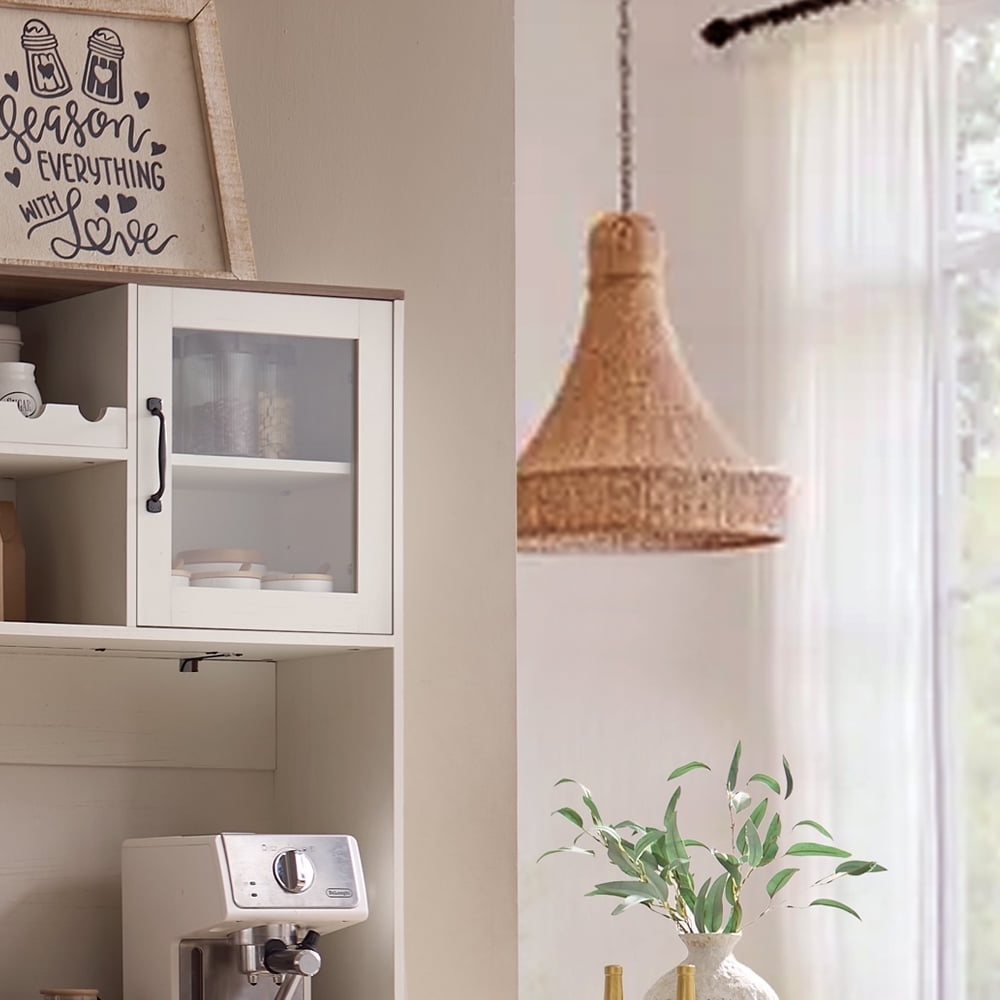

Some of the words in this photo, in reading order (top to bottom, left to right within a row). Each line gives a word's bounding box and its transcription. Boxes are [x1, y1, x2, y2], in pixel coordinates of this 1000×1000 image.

[37, 150, 166, 191] EVERYTHING
[18, 191, 63, 223] WITH
[27, 187, 179, 260] Love
